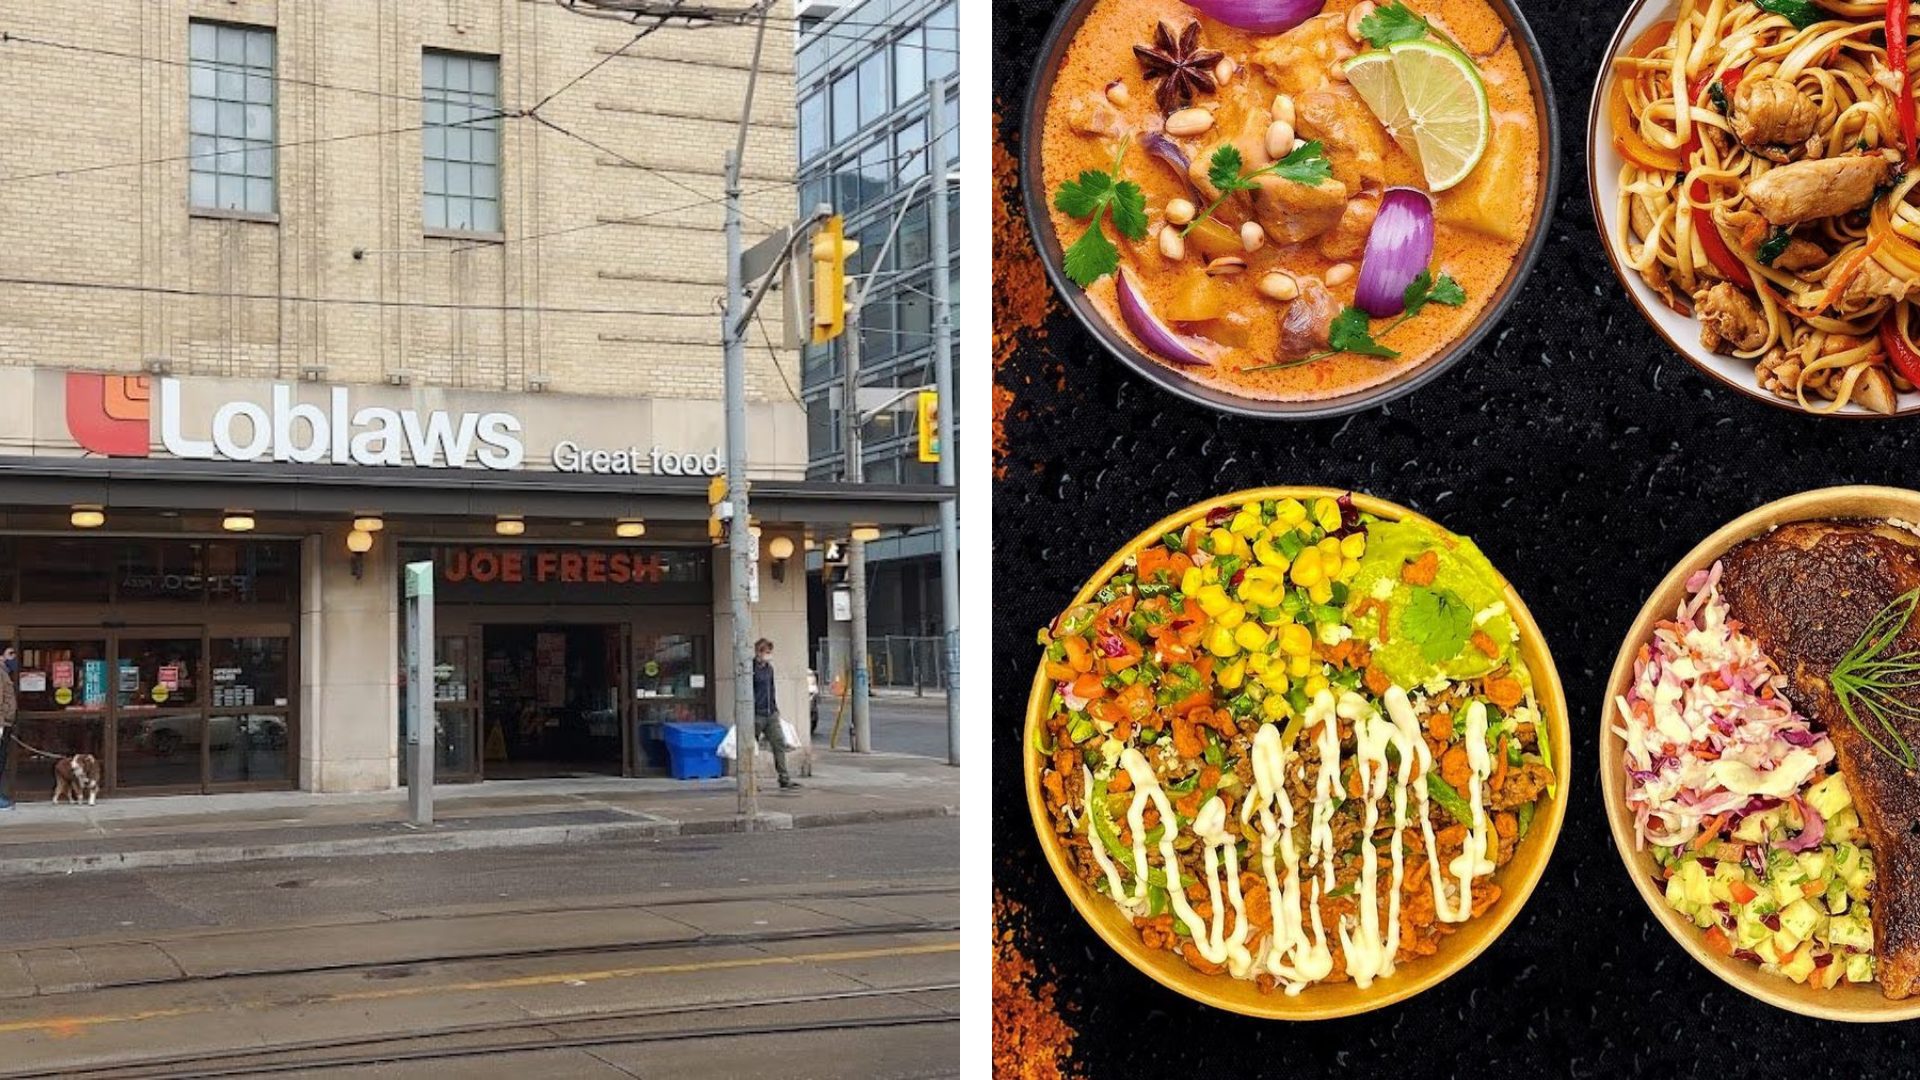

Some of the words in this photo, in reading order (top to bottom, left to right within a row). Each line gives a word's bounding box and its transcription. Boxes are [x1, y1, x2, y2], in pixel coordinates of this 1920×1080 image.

[161, 377, 524, 470] Loblaws
[552, 440, 640, 474] Great
[649, 446, 722, 476] food
[445, 550, 523, 582] JOE
[536, 551, 663, 583] FRESH
